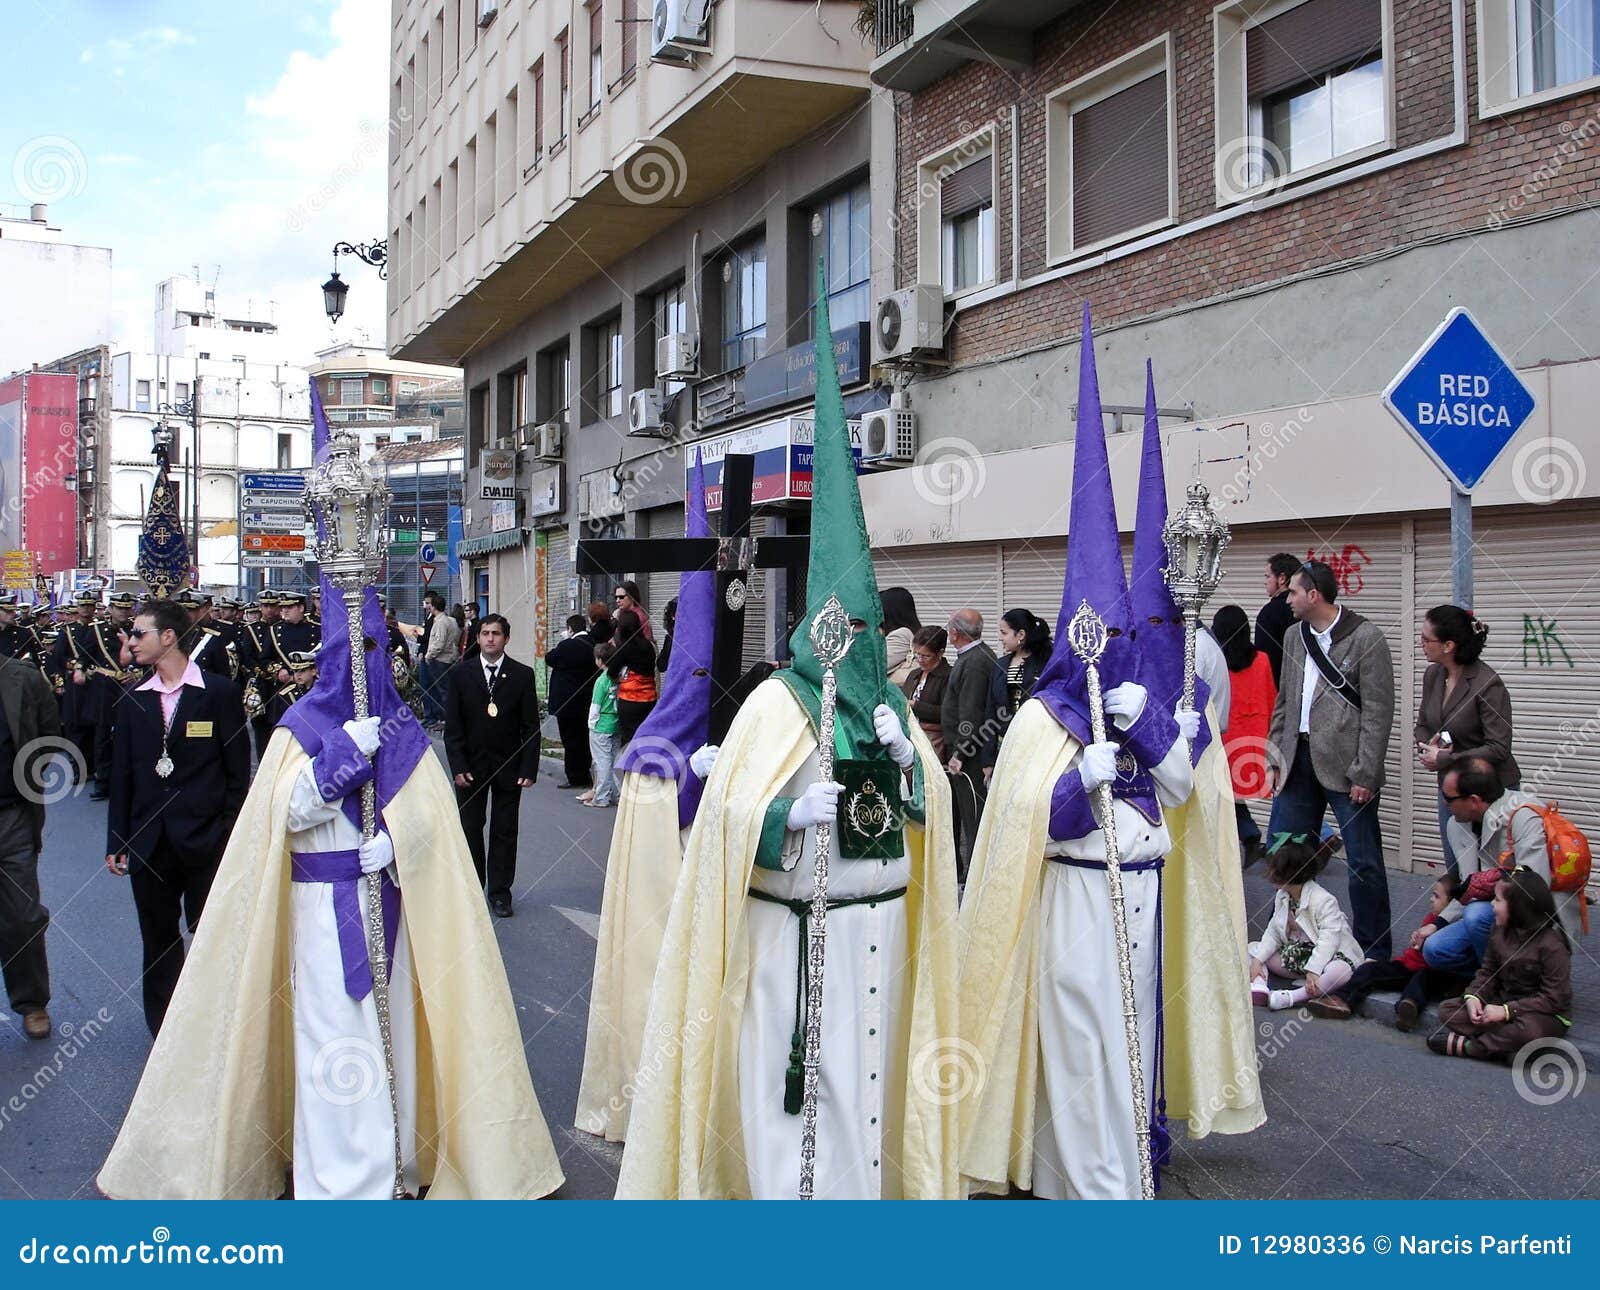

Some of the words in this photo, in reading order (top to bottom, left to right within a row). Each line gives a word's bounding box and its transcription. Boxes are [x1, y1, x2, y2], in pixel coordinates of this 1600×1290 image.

[1439, 374, 1490, 398] RED
[1417, 398, 1512, 427] BÁSICA
[483, 486, 501, 497] EVA
[502, 487, 514, 498] III
